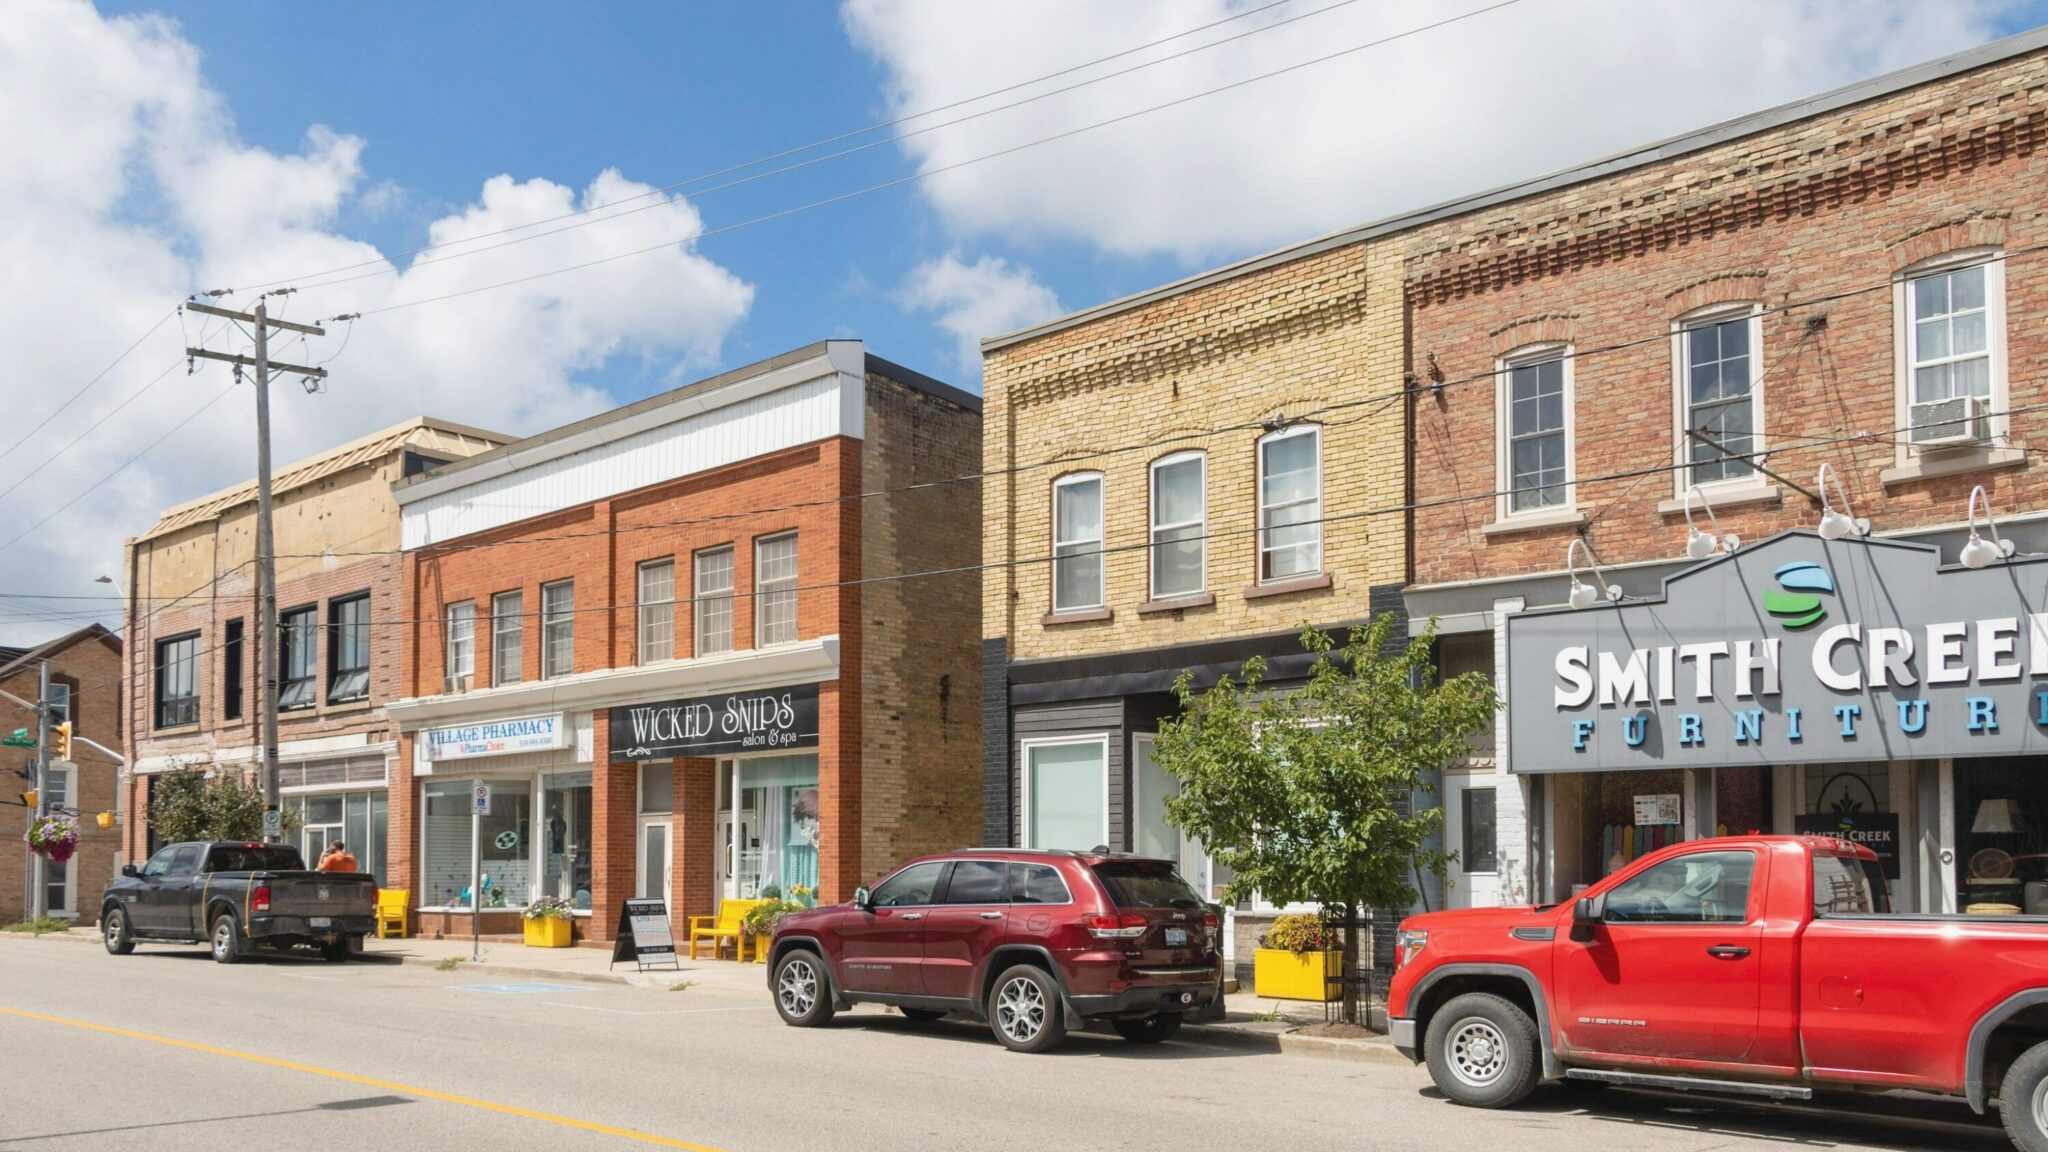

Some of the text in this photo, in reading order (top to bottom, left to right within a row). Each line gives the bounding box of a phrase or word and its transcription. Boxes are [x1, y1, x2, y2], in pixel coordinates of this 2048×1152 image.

[1554, 638, 1781, 709] SMITH
[630, 692, 795, 744] WICKED SNIPS
[428, 718, 554, 745] VILLAGE PHARMACY
[742, 729, 797, 747] salon & spa
[1849, 830, 1892, 842] CREEK
[1578, 1017, 1646, 1026] SIERRA
